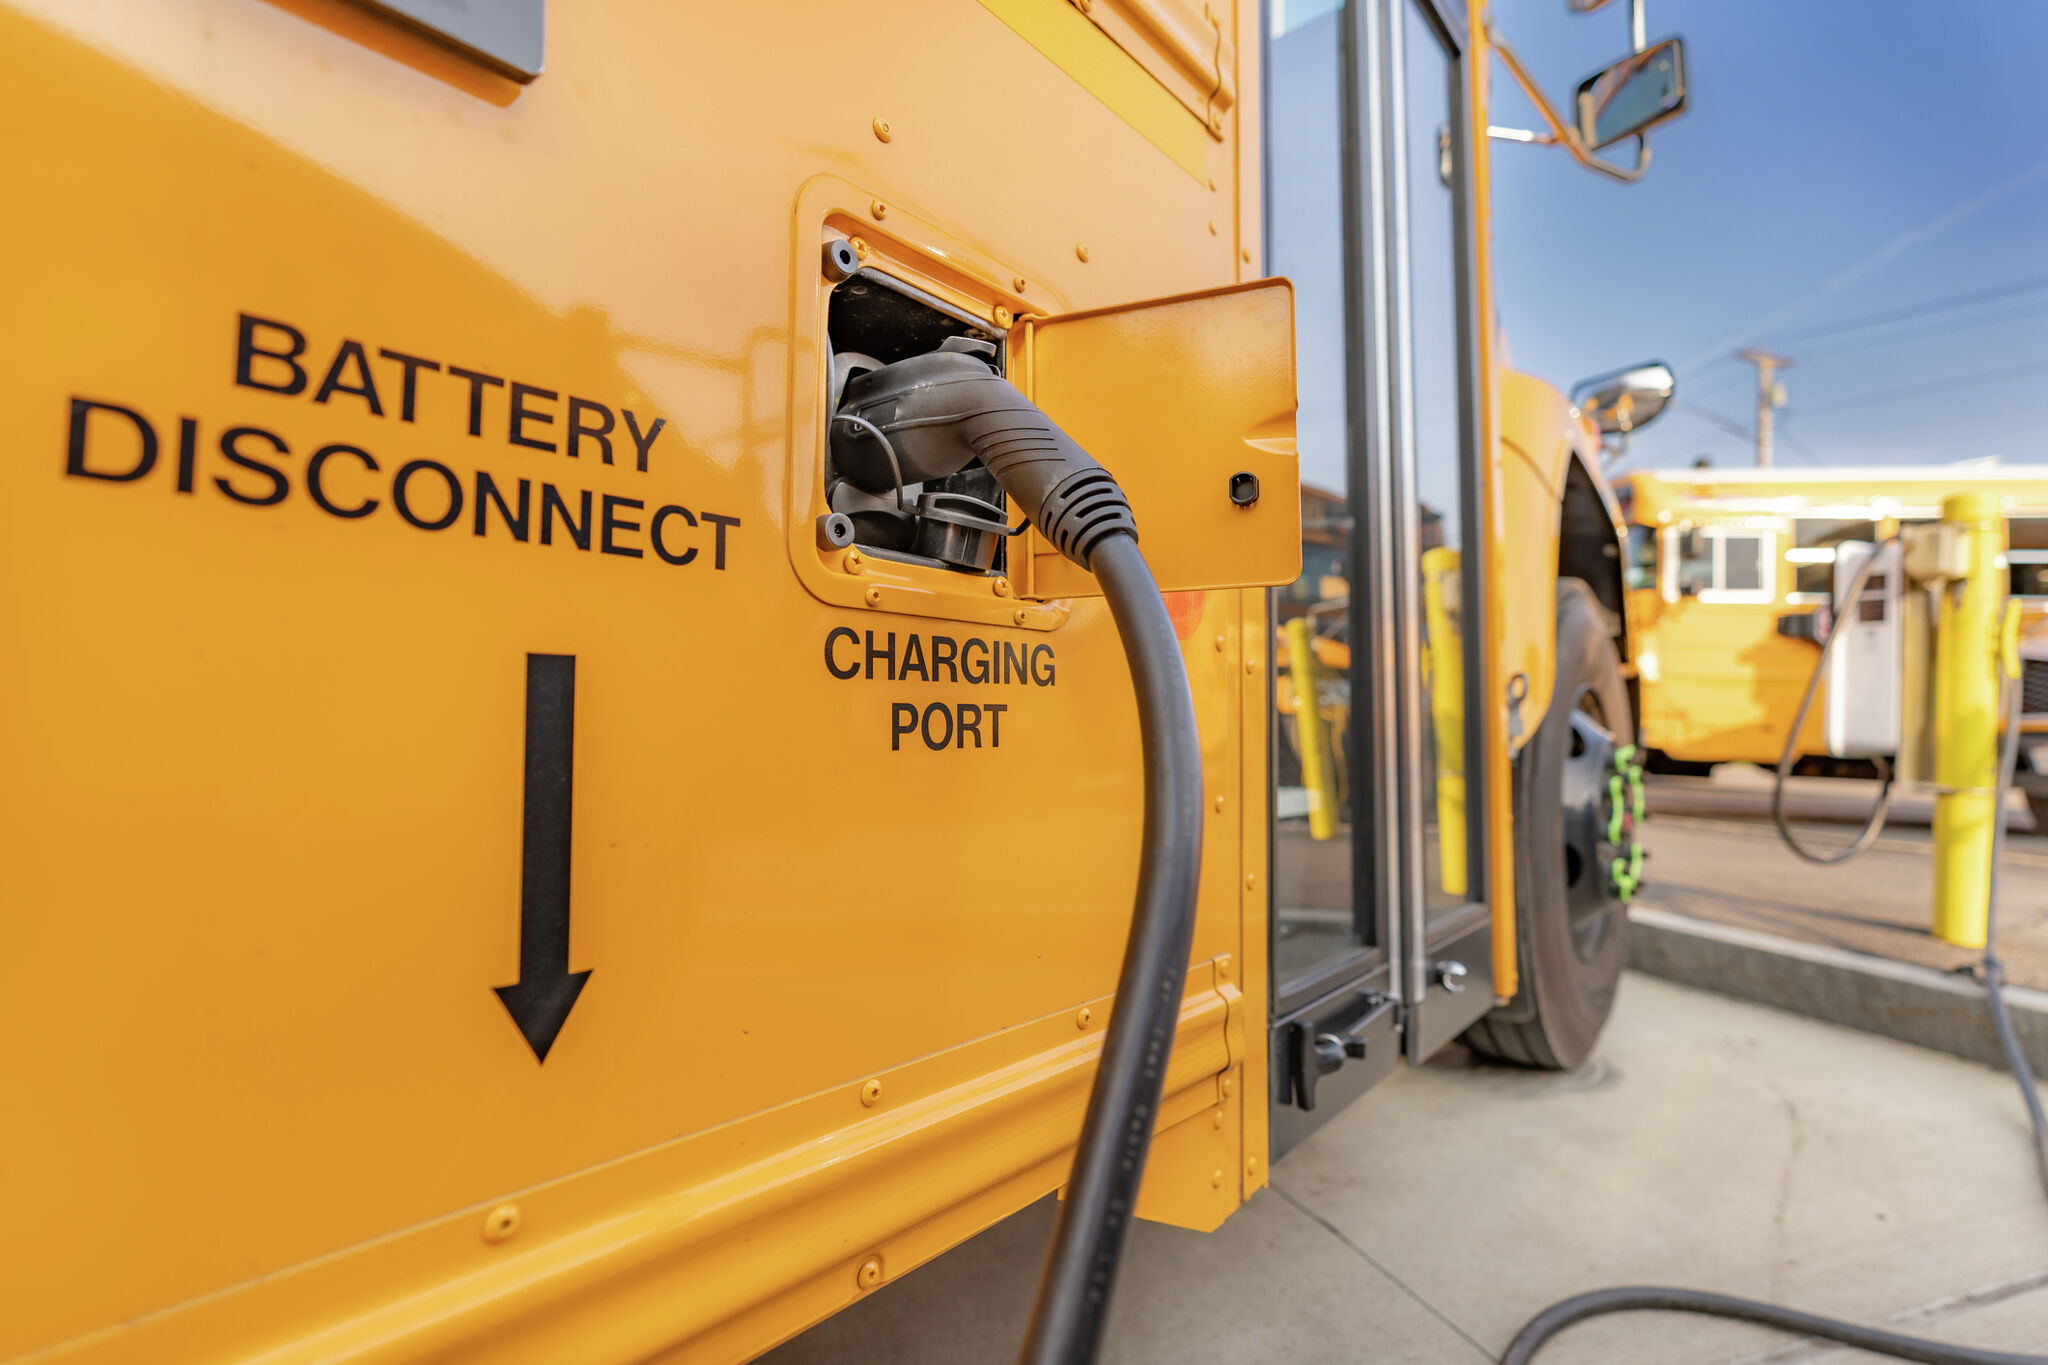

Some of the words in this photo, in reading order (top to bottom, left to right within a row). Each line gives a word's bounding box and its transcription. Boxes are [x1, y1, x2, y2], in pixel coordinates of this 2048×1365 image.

[235, 311, 666, 474] BATTERY
[64, 396, 741, 571] DISCONNECT
[824, 625, 1056, 687] CHARGING
[891, 702, 1008, 752] PORT
